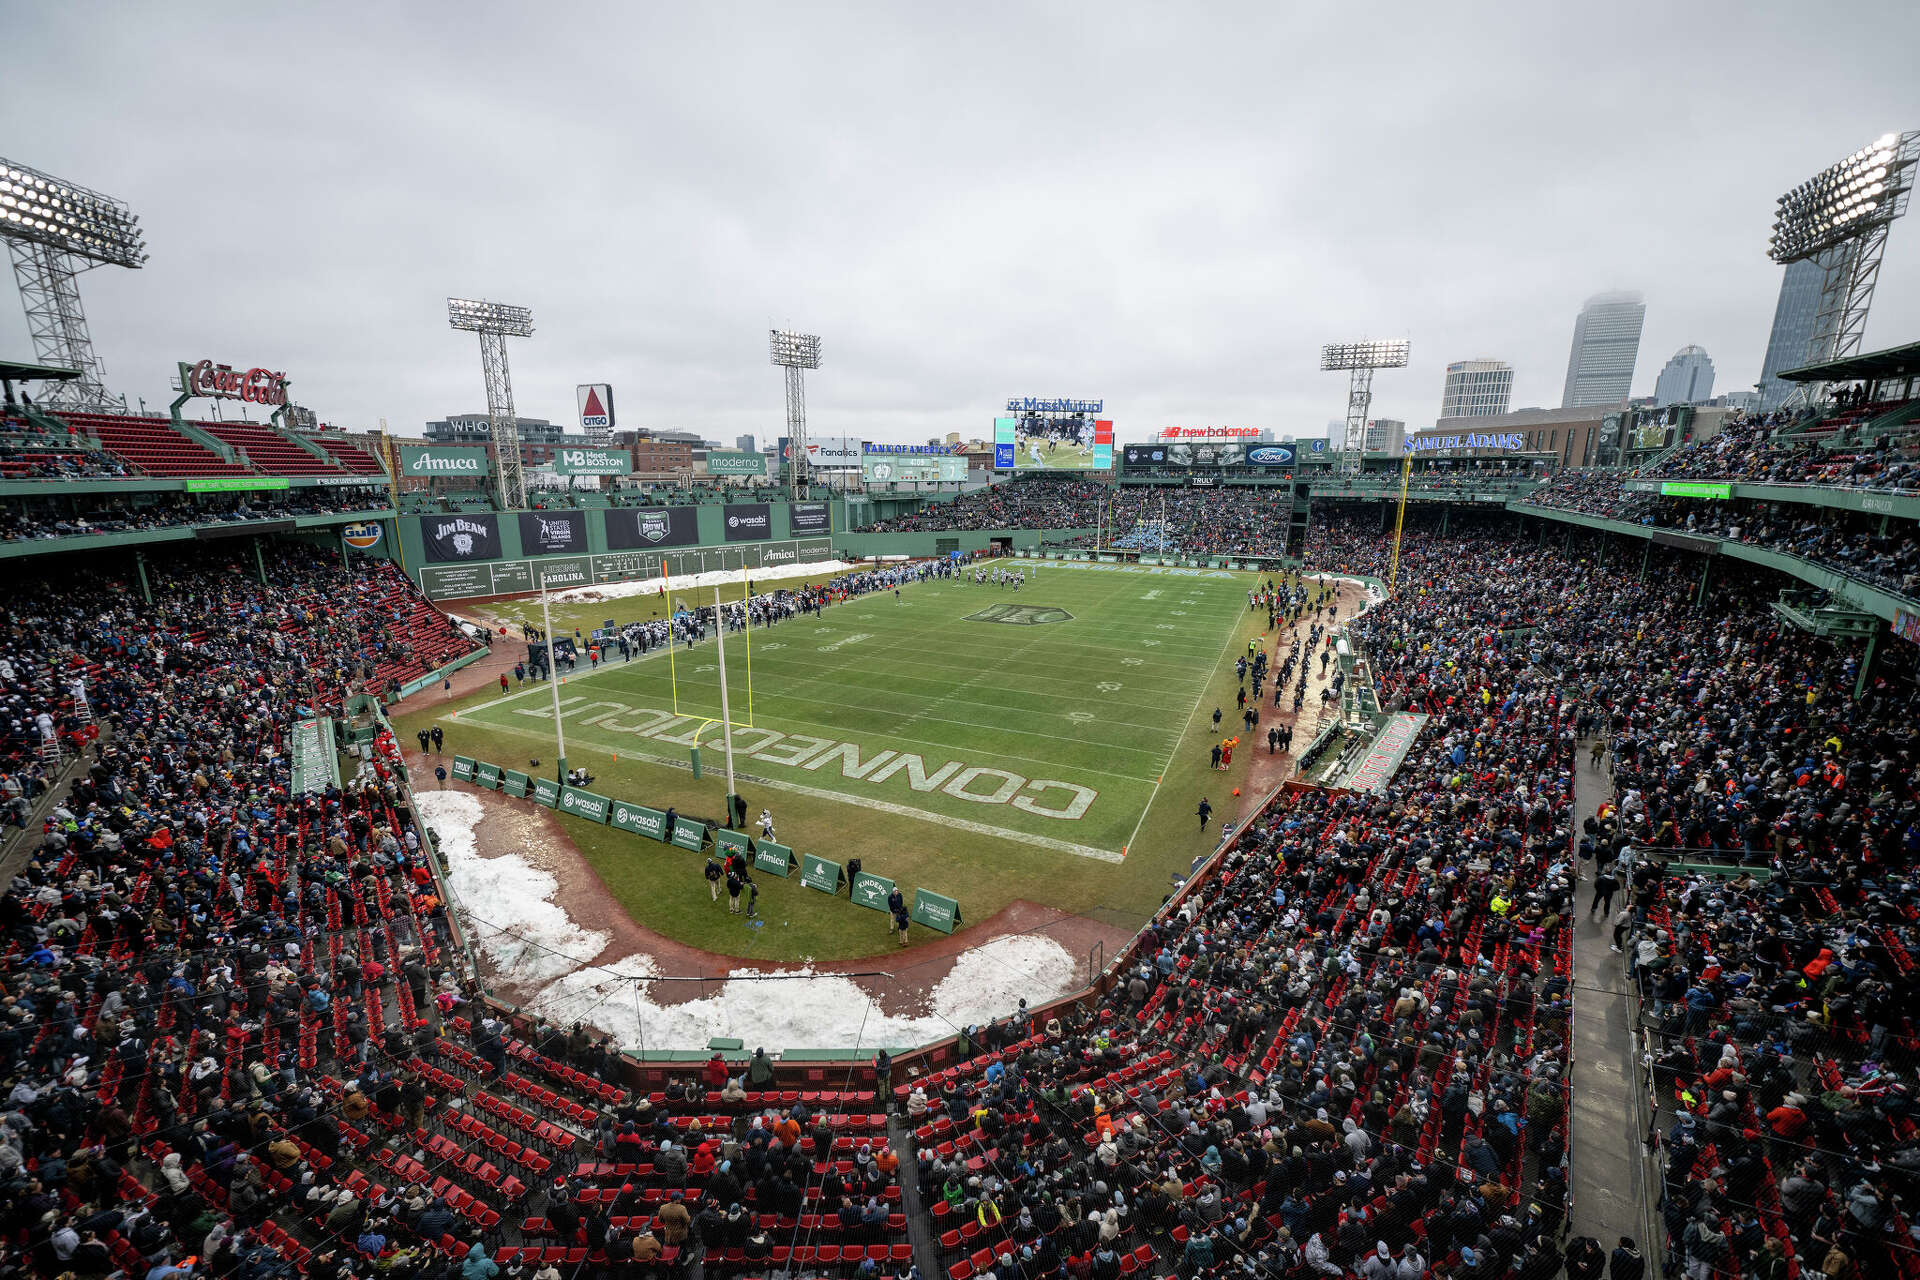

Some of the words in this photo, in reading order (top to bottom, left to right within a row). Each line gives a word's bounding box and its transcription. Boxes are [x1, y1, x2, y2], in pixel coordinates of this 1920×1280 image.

[190, 359, 286, 405] Coca-Cola
[1024, 397, 1103, 413] MassMutual
[583, 417, 607, 425] CITGO
[864, 443, 892, 453] BANK
[895, 444, 906, 454] OF
[910, 445, 951, 455] AMERICA
[1403, 434, 1462, 453] SAMUEL
[1464, 432, 1523, 450] ADAMS
[413, 453, 478, 470] Amica
[563, 451, 585, 466] MB
[586, 451, 606, 459] Meet
[712, 457, 759, 467] moderna
[1258, 450, 1282, 461] Ford
[739, 515, 766, 524] wasabi
[343, 526, 379, 537] Gulf
[436, 523, 456, 540] JIM
[456, 519, 487, 538] BEAM
[642, 522, 667, 534] BOWL
[764, 549, 795, 560] Amica
[511, 696, 1100, 820] CONNECTICUT
[478, 770, 495, 782] Amica
[1350, 753, 1393, 789] BOSTON
[575, 797, 602, 812] wasabi
[629, 812, 661, 829] wasabi
[758, 850, 785, 866] Amica
[804, 873, 832, 887] FOUNDATION
[858, 880, 887, 896] KINDER'S
